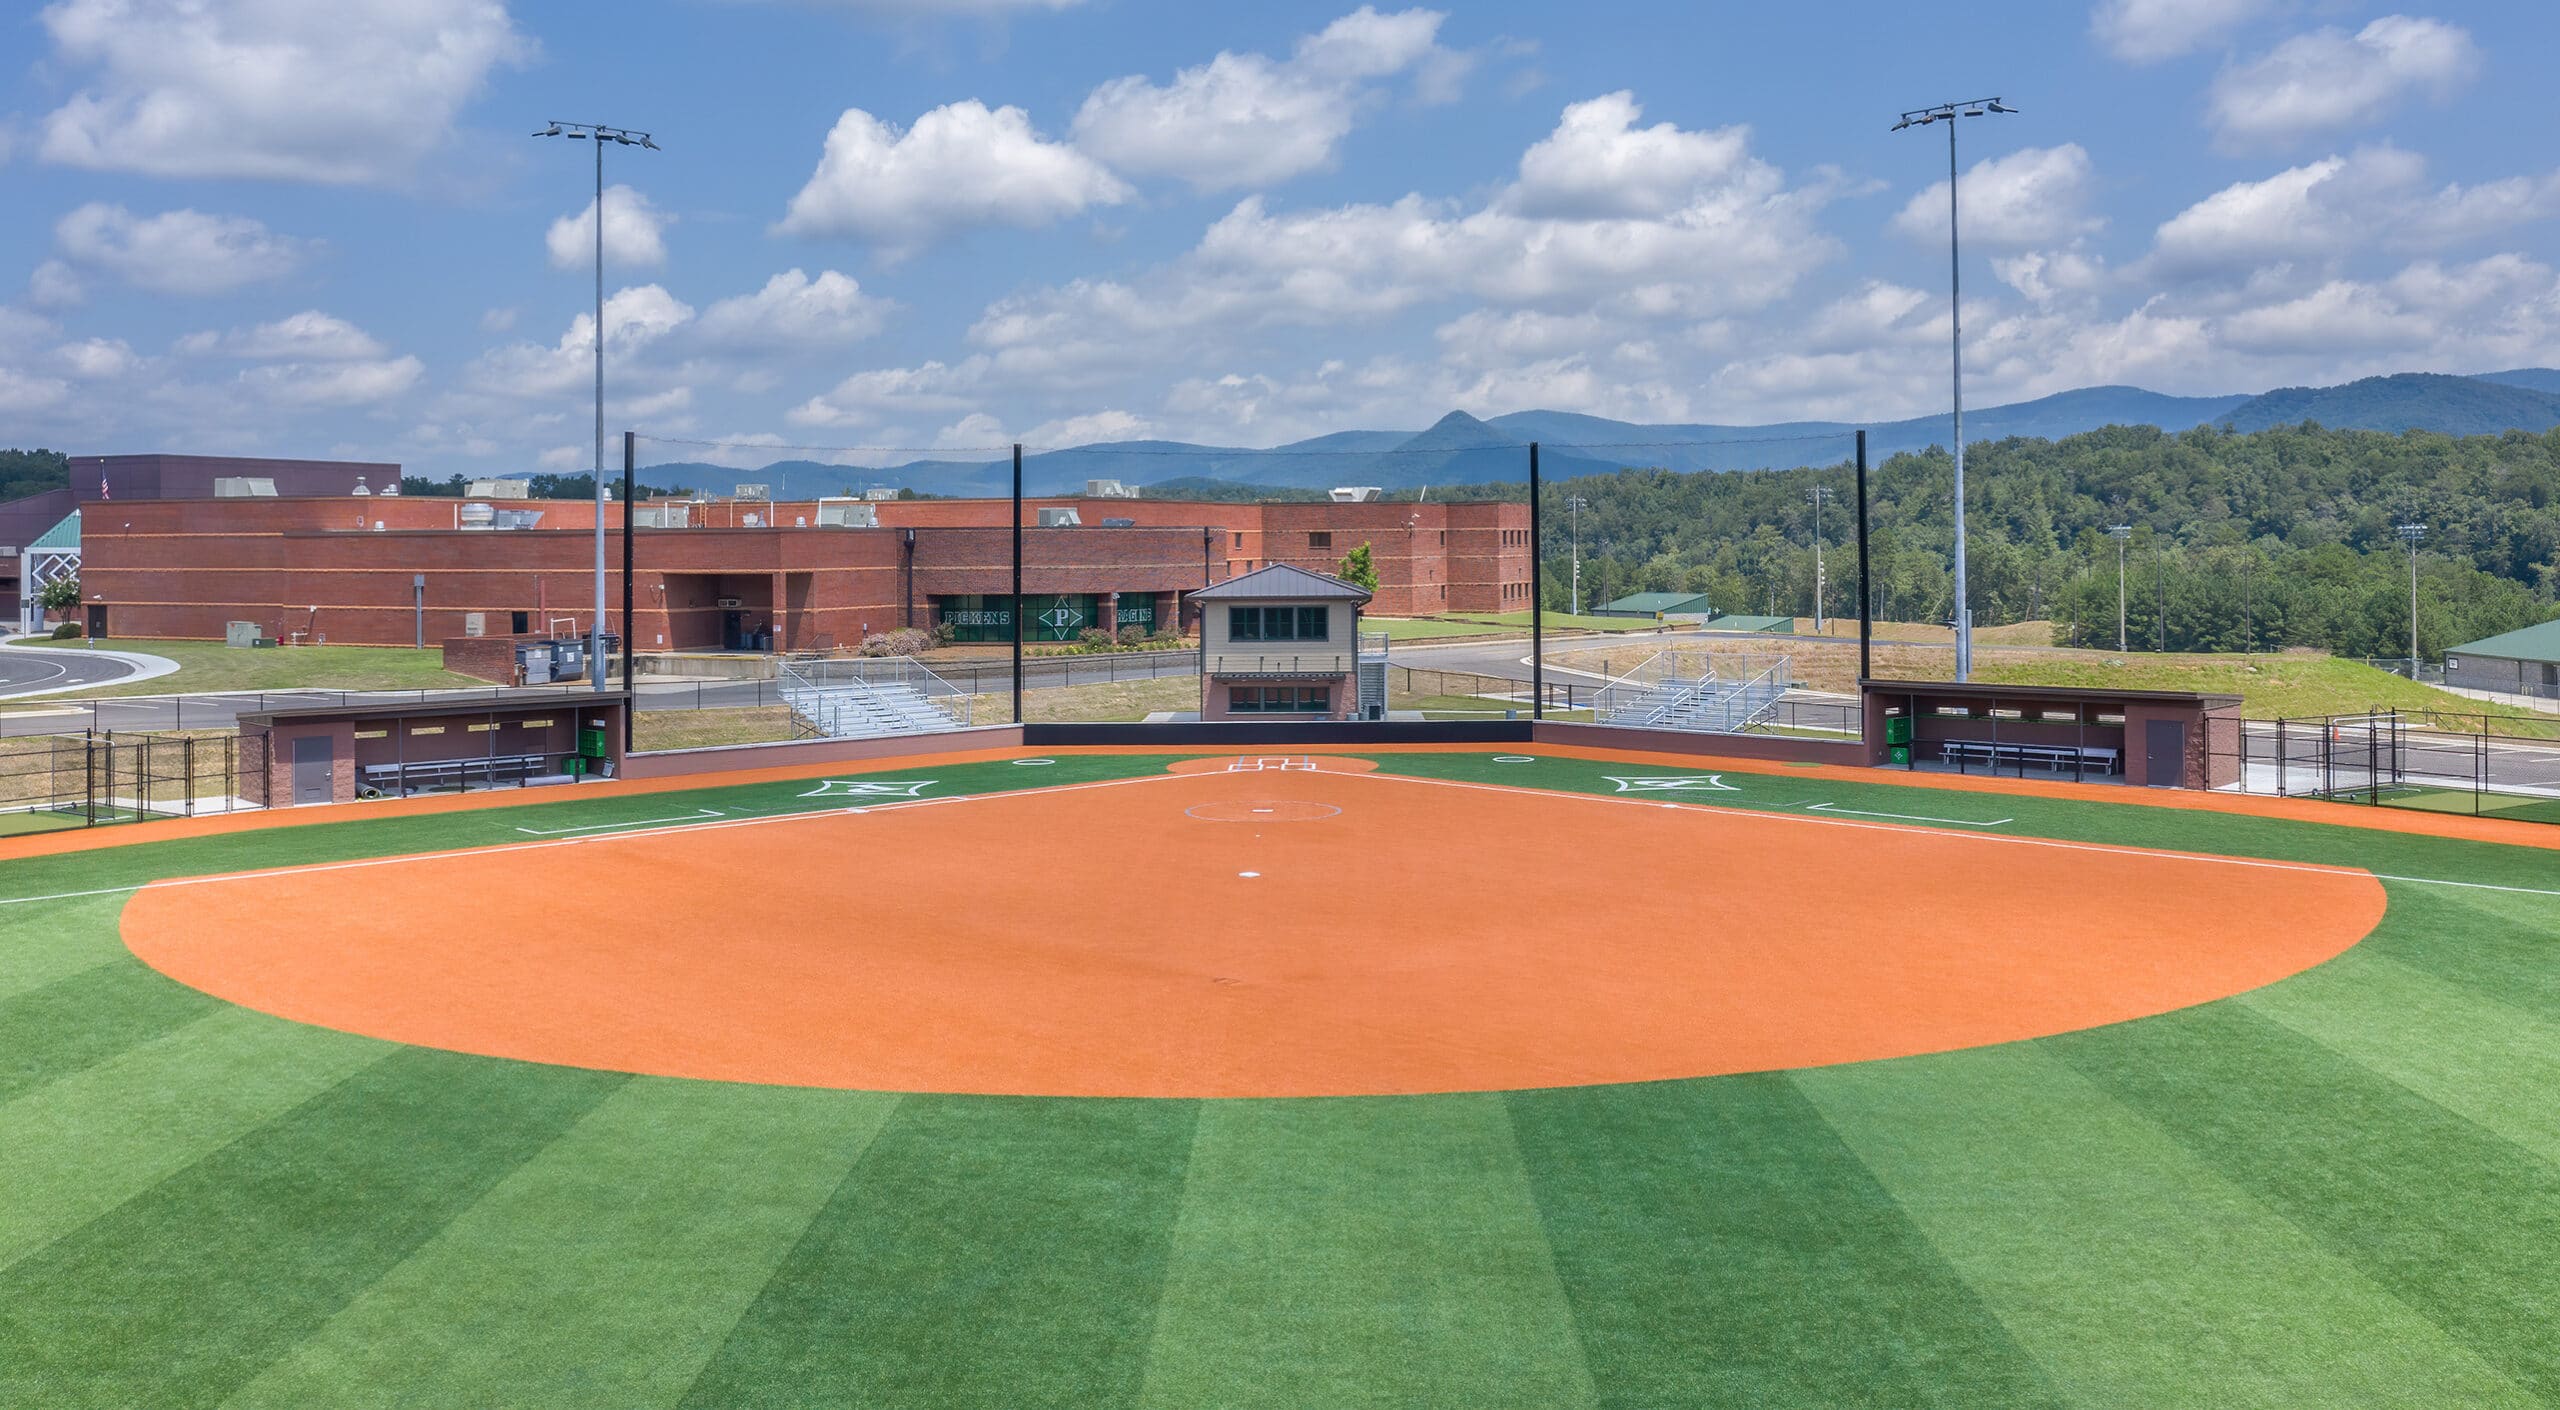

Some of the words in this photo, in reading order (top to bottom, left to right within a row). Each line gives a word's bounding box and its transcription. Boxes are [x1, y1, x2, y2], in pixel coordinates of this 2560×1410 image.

[943, 611, 1010, 625] PICKENS
[1054, 609, 1069, 627] P
[1117, 608, 1151, 623] RAGONS
